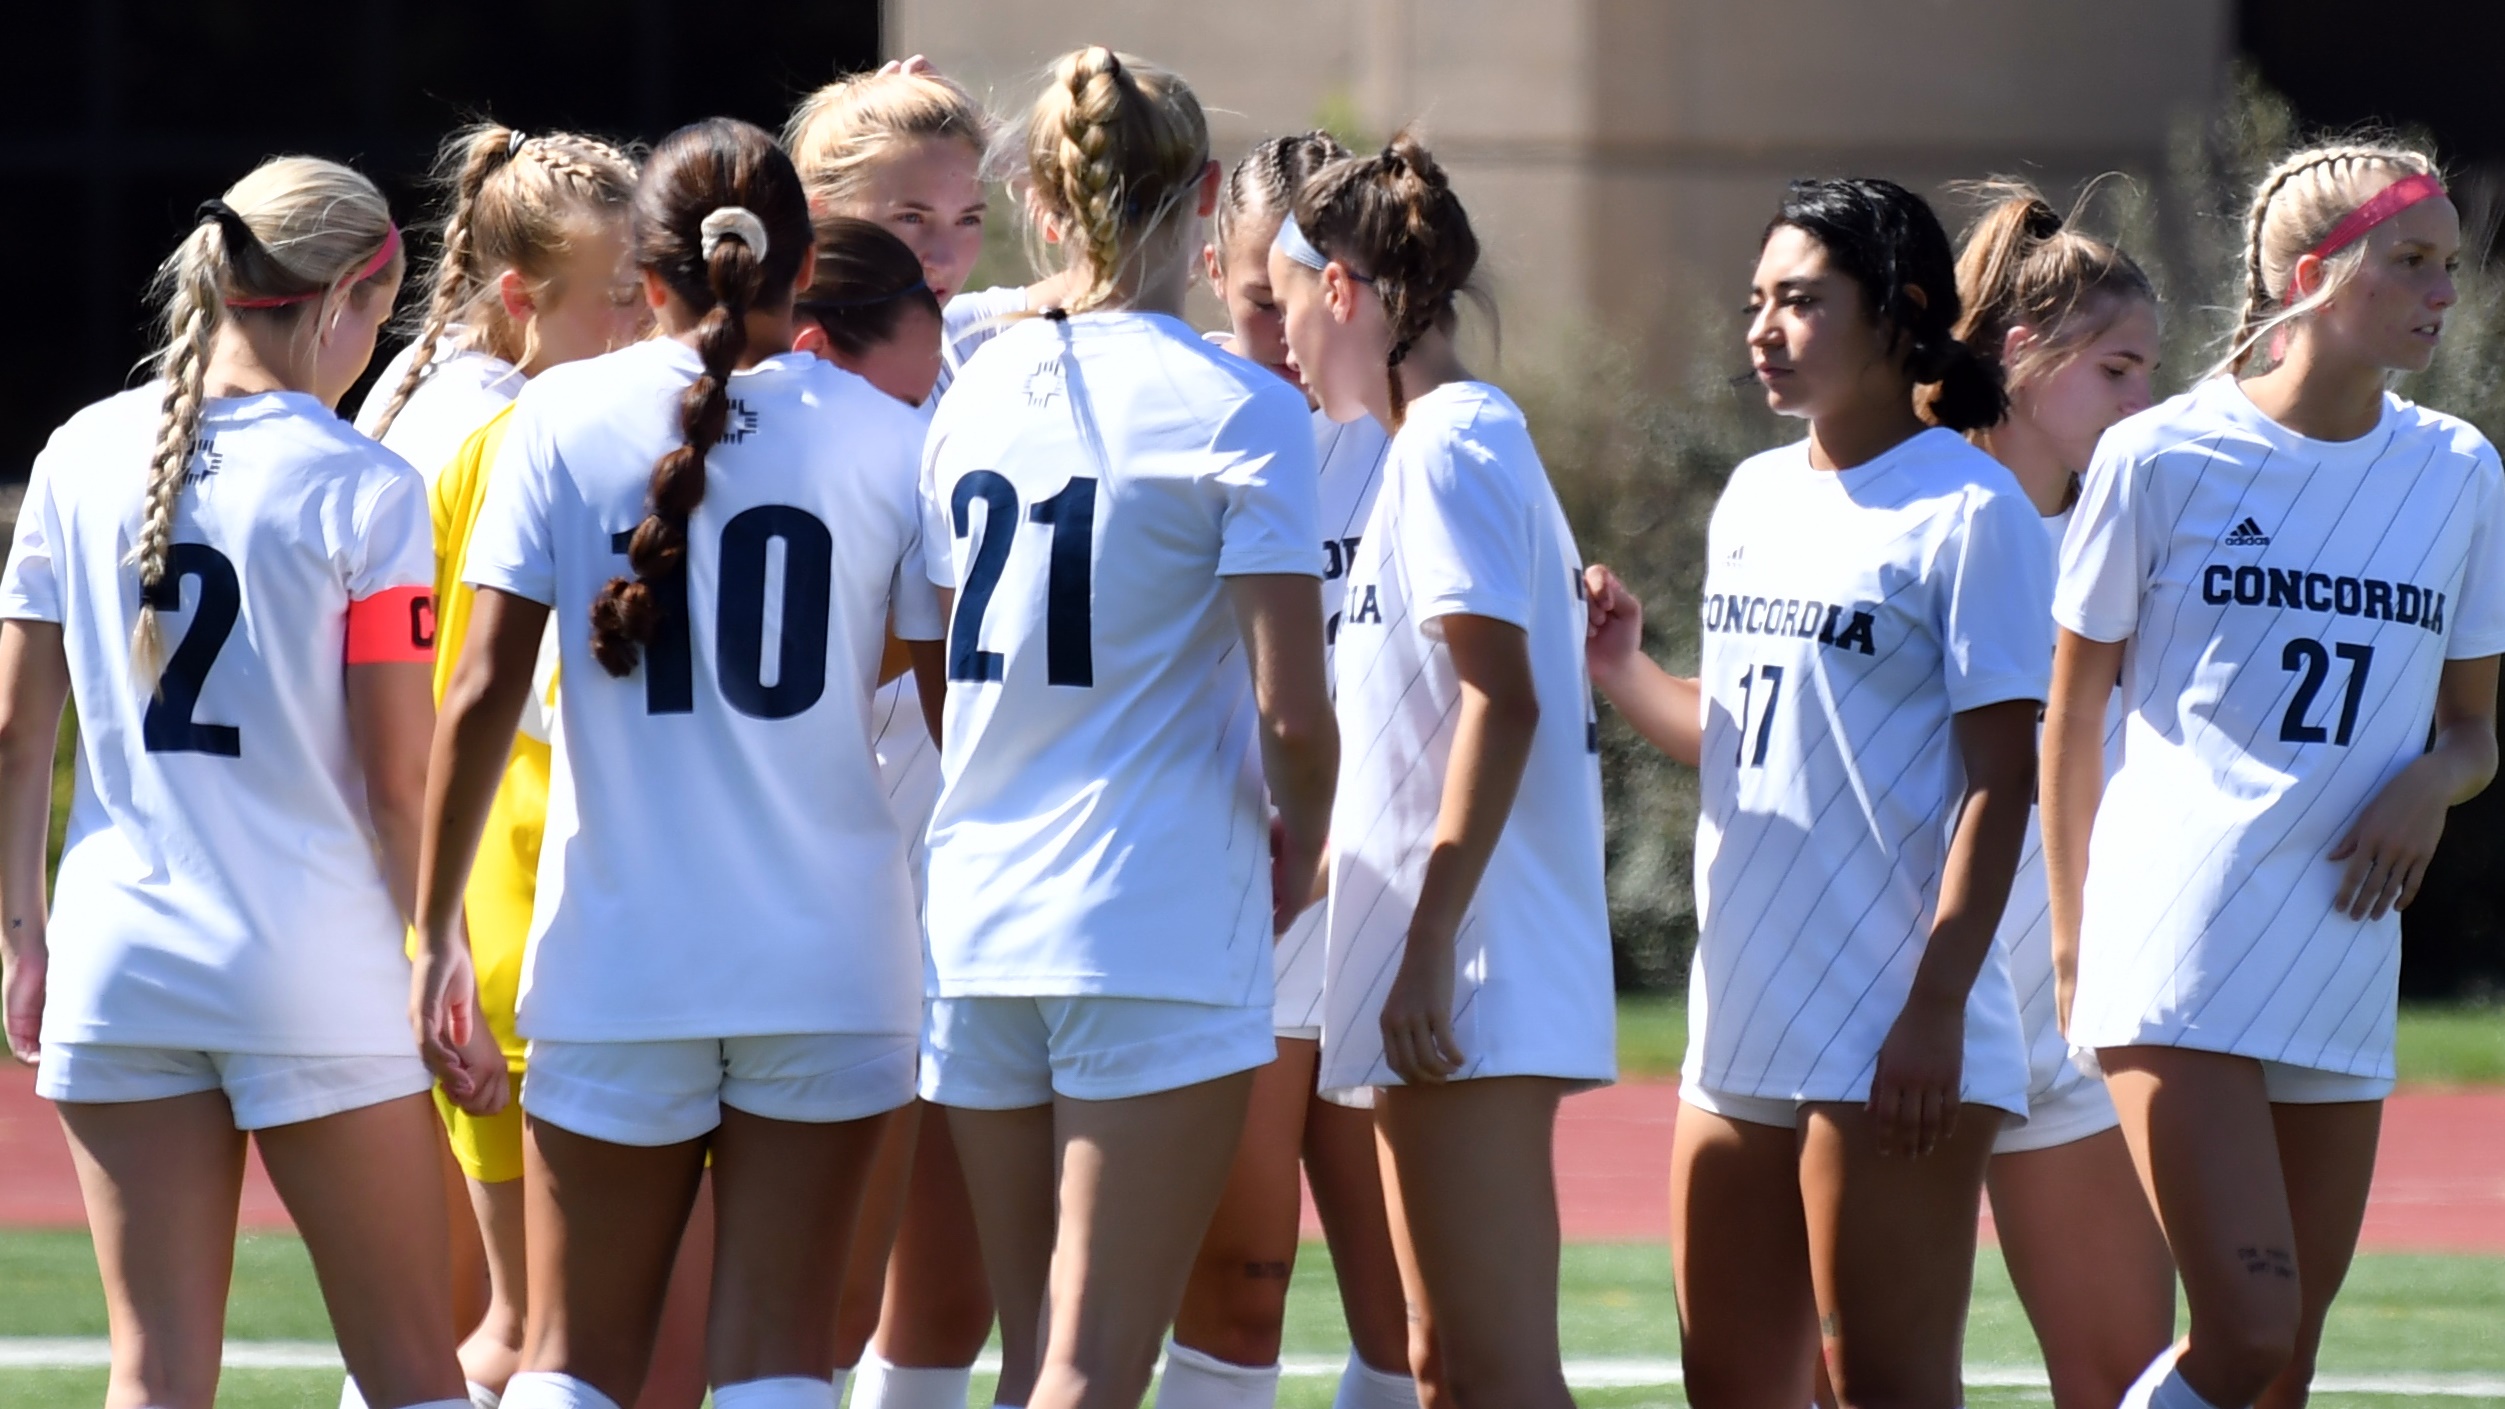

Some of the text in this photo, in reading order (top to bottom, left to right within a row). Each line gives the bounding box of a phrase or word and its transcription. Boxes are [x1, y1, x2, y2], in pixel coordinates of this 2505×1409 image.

[948, 469, 1099, 688] 21
[2225, 536, 2270, 546] adidas
[139, 542, 241, 758] 2
[410, 595, 436, 651] C
[611, 504, 833, 721] 10
[1702, 593, 1876, 656] ONCORDIA
[2202, 564, 2446, 635] CONCORDIA
[1734, 662, 1785, 769] 17
[2279, 637, 2376, 747] 27
